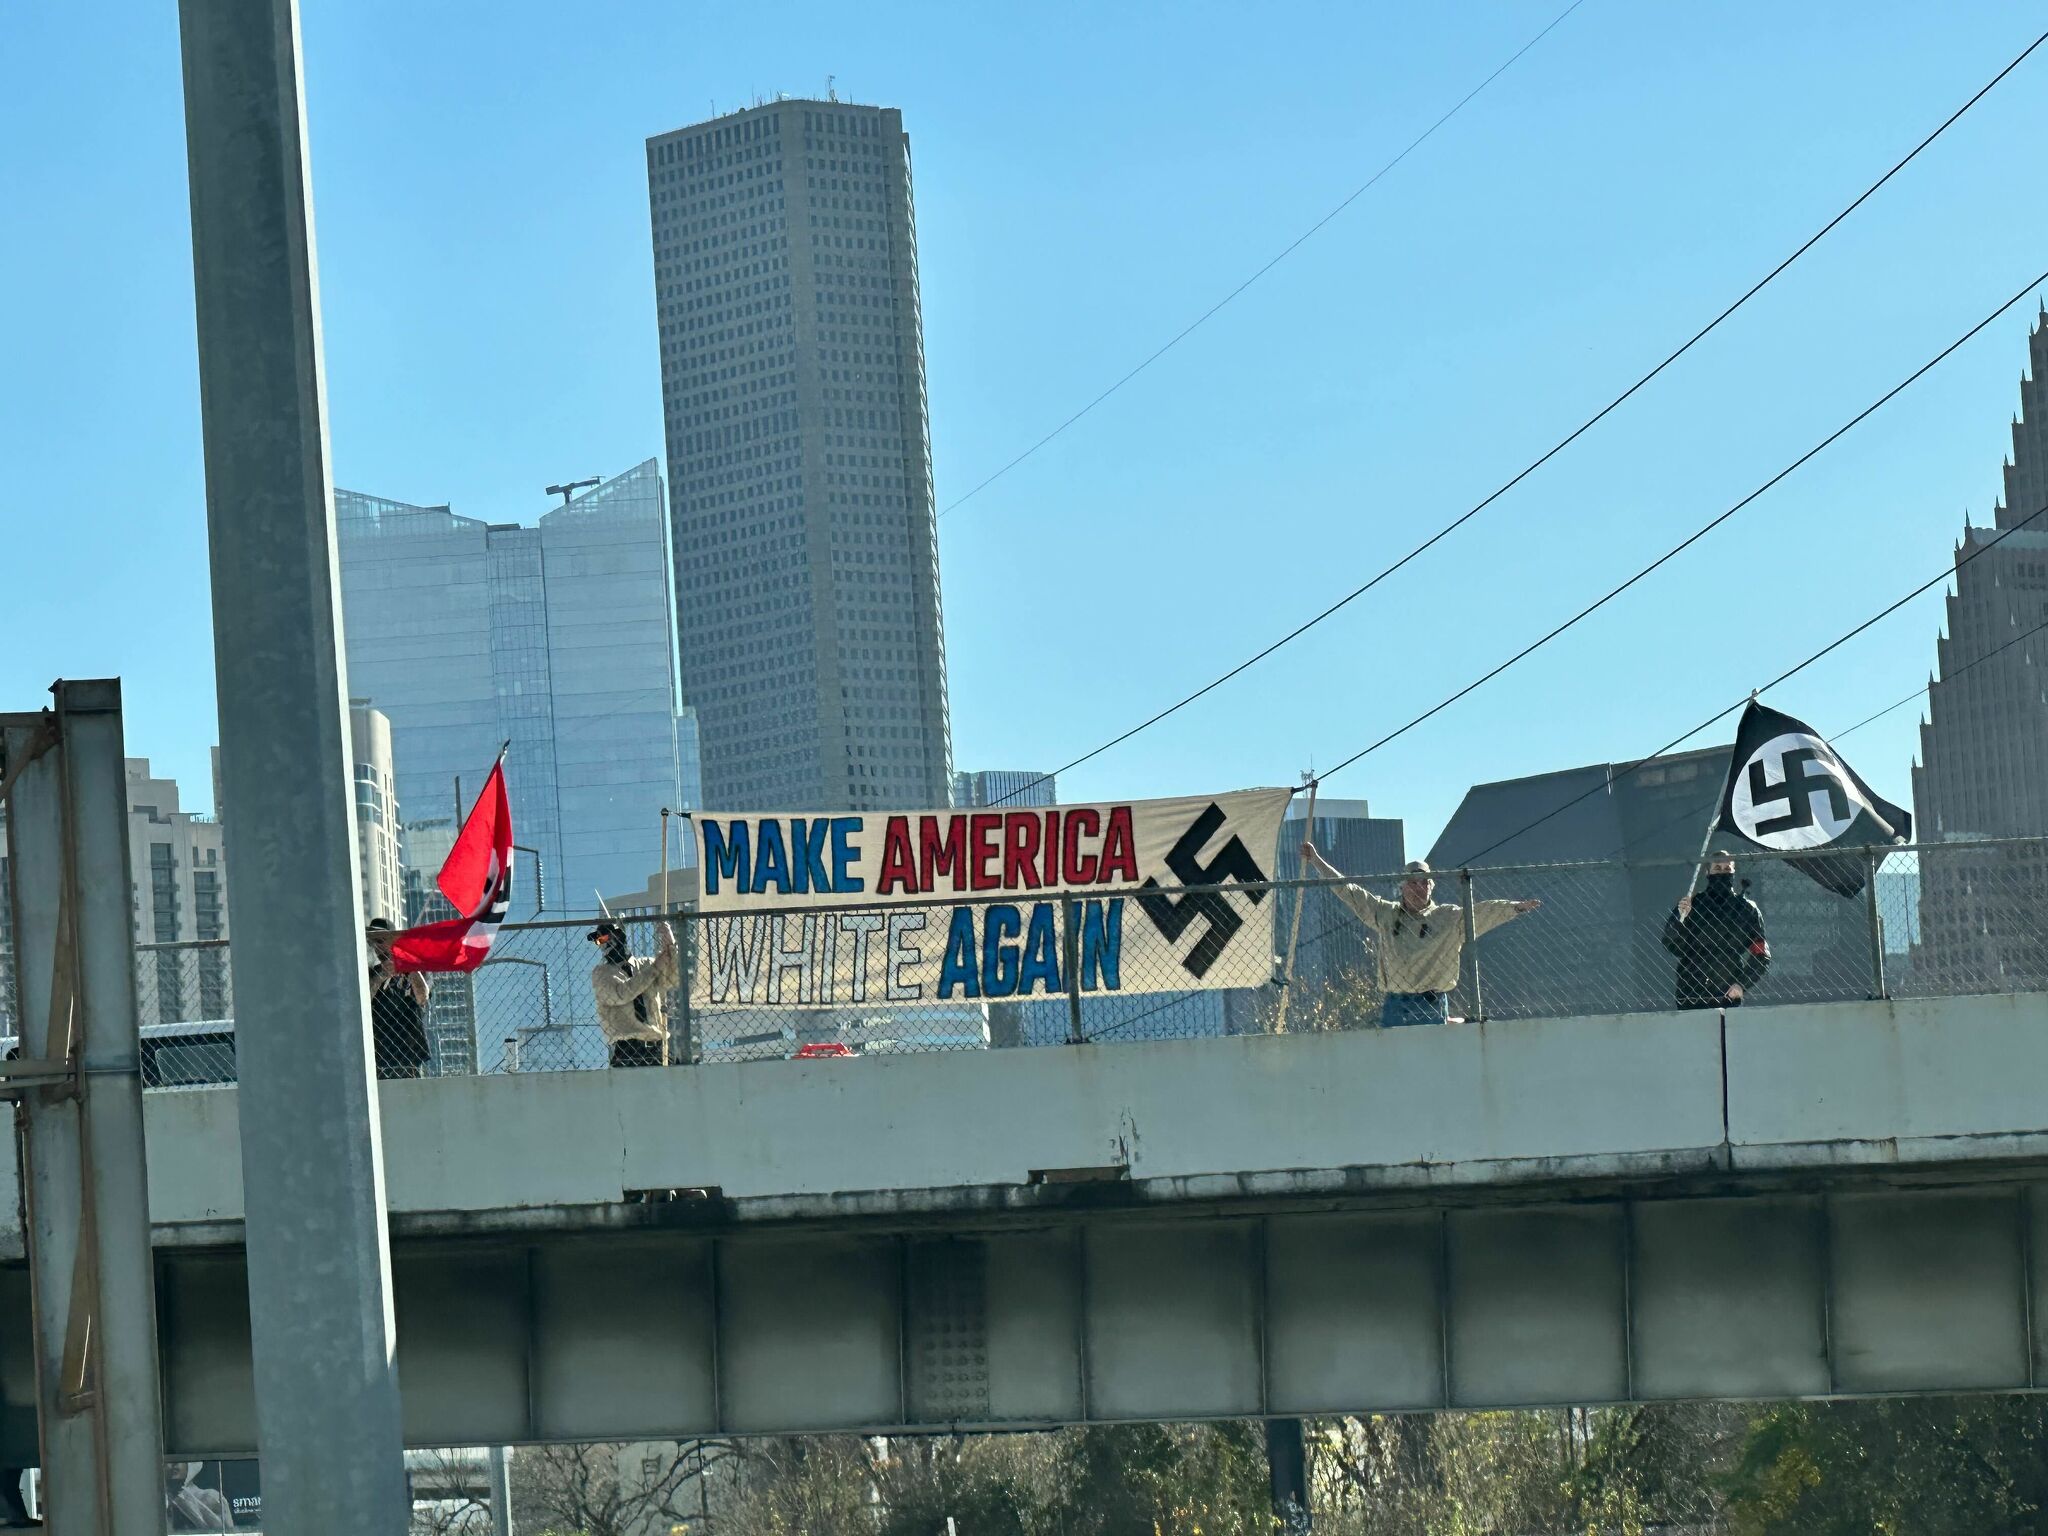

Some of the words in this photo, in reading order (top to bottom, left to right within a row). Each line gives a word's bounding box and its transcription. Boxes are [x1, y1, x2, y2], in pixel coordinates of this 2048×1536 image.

[701, 817, 864, 894] MAKE
[877, 807, 1139, 895] AMERICA
[706, 912, 927, 1003] WHITE
